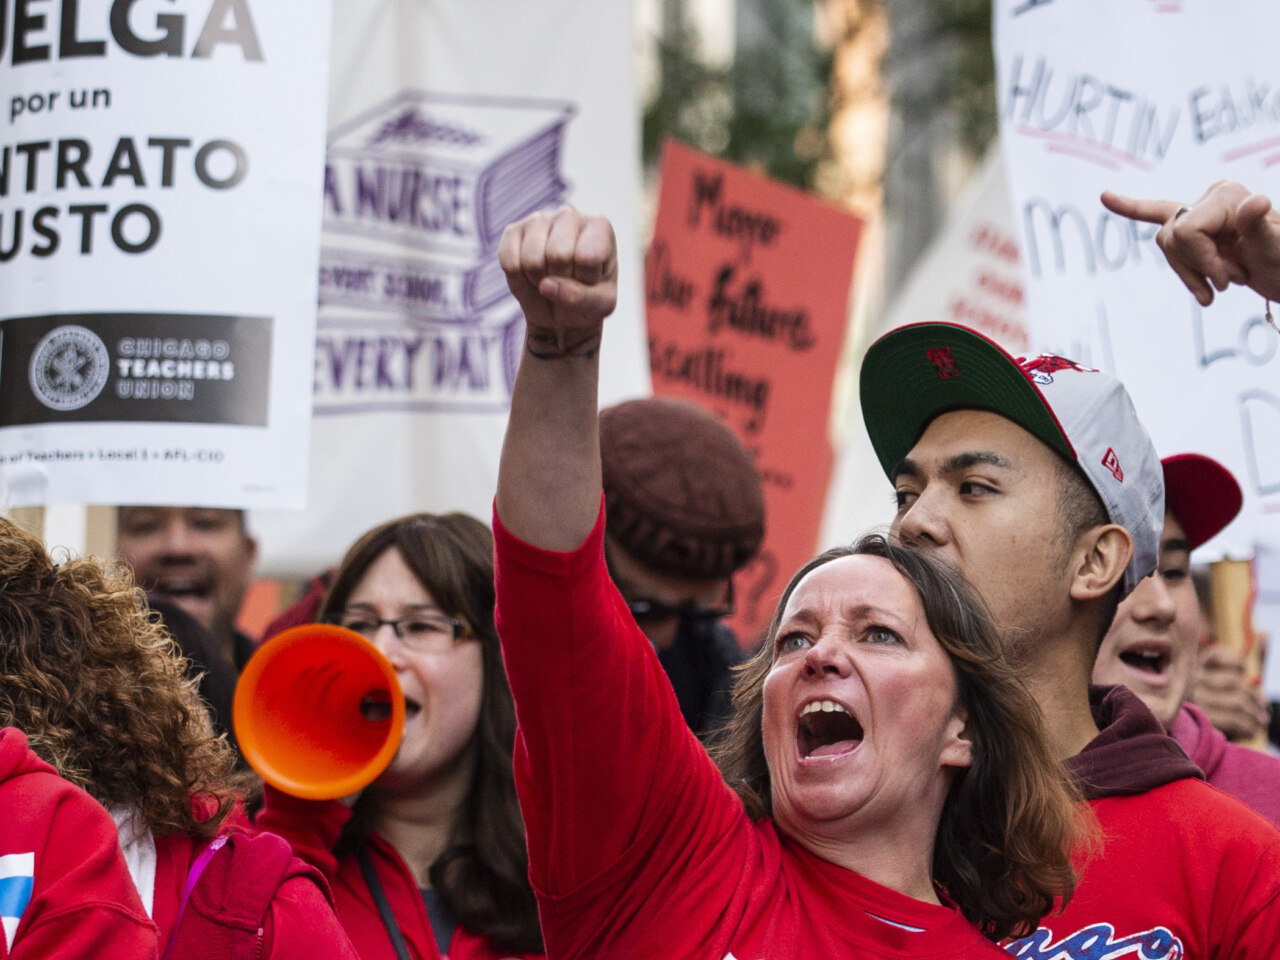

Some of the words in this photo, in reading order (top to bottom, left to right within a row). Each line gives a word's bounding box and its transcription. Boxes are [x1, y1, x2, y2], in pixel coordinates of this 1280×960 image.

[0, 0, 265, 68] ELGA
[10, 90, 59, 125] por
[69, 87, 111, 109] un
[1004, 52, 1181, 163] HURTIN
[0, 137, 249, 197] TRATO
[356, 164, 475, 236] NURSE
[116, 337, 230, 360] CHICAGO
[117, 359, 235, 381] TEACHERS
[115, 379, 195, 400] UNION
